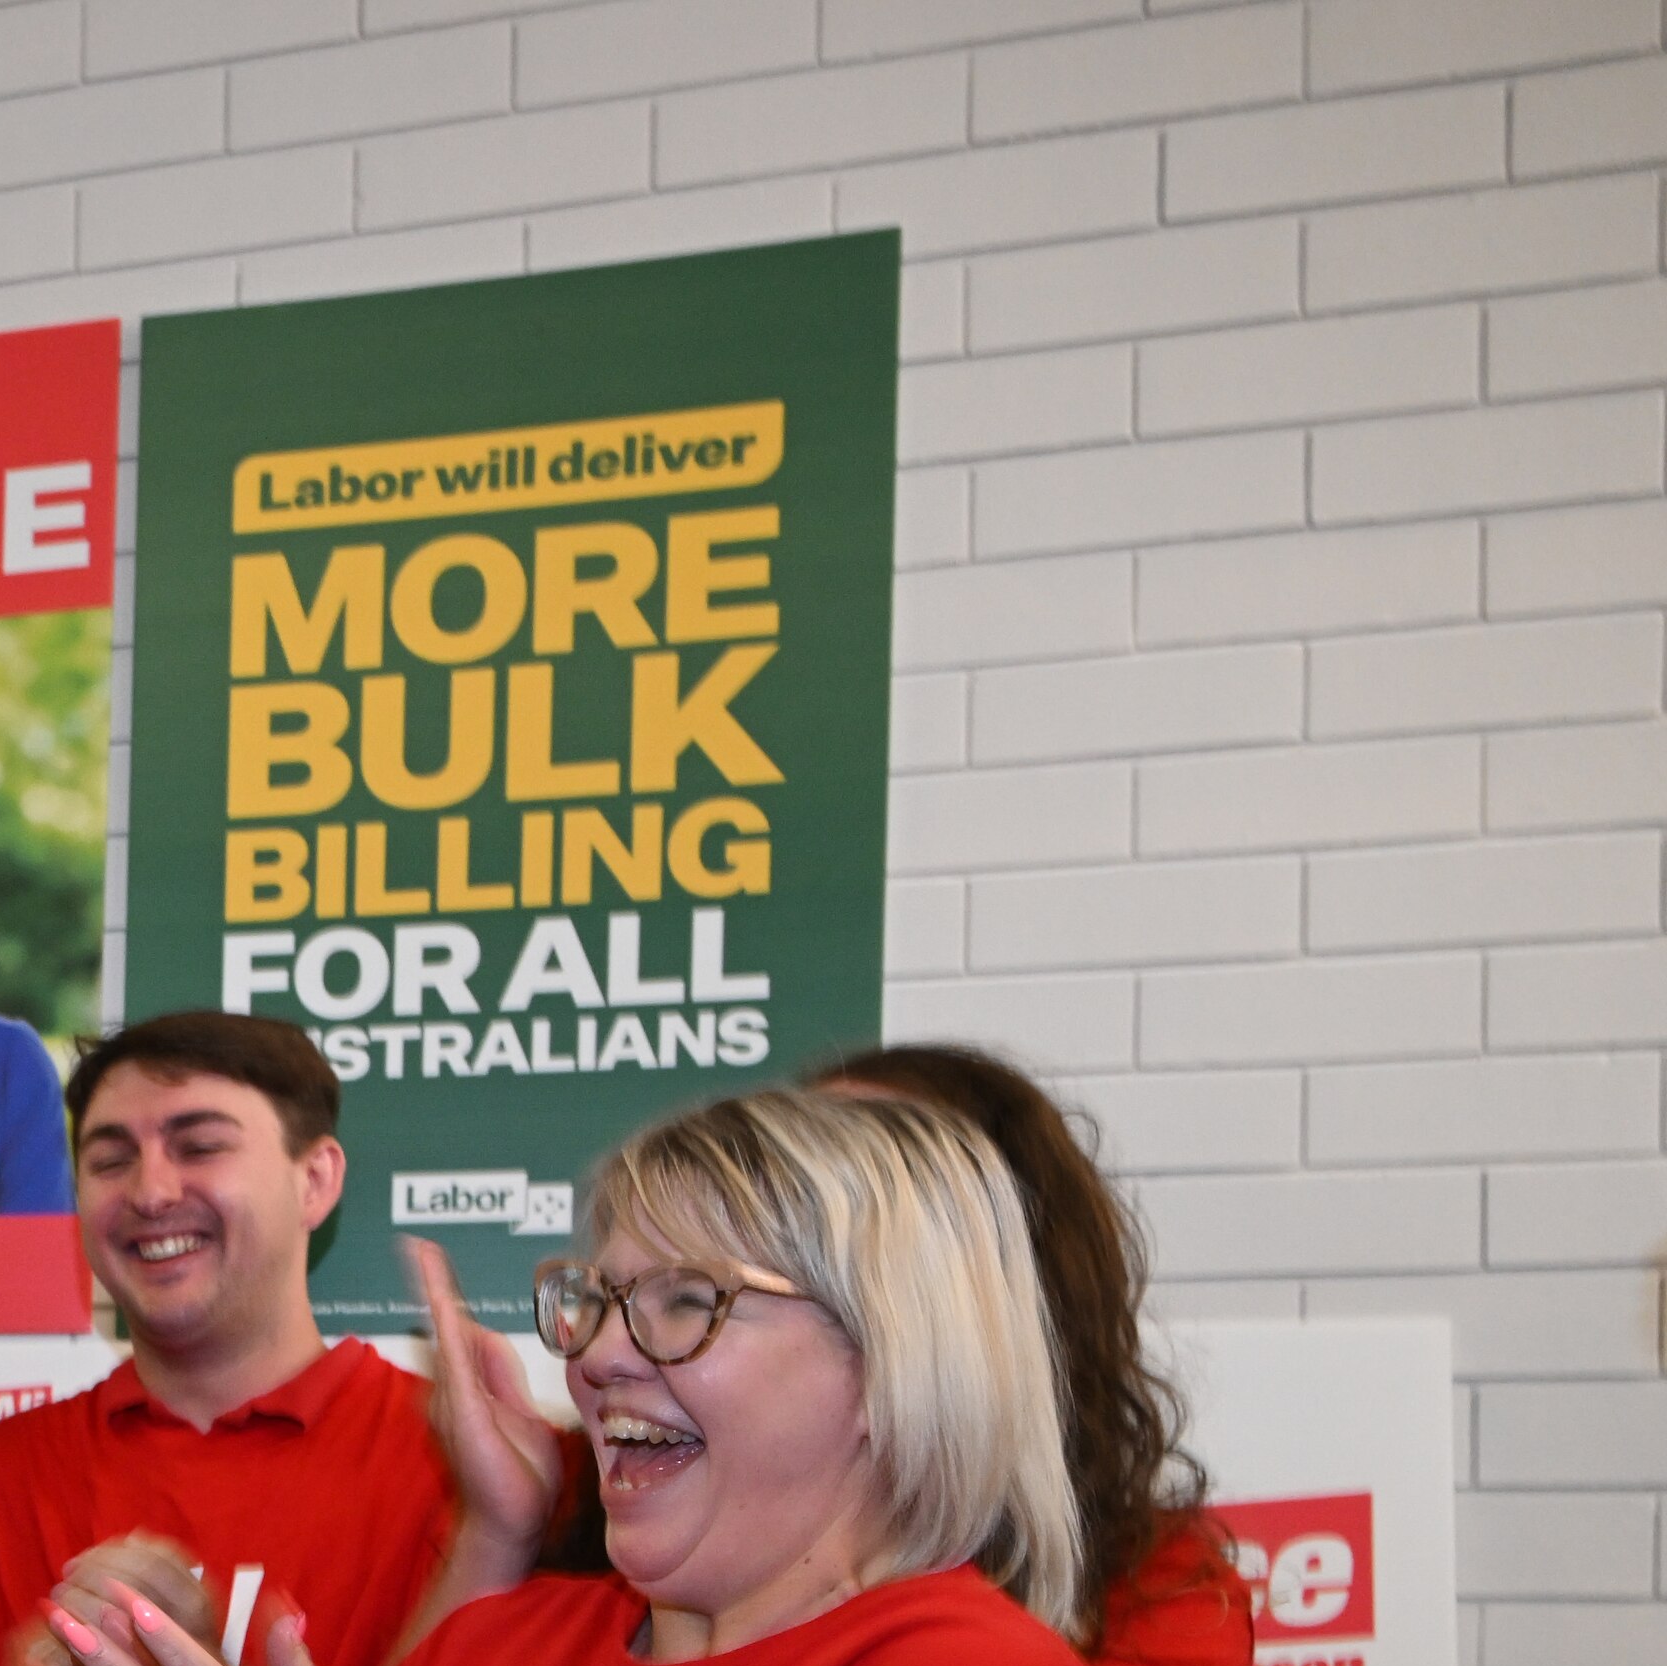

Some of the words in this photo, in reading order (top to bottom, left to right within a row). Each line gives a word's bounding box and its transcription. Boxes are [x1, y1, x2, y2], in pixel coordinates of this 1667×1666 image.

[259, 463, 424, 511] Labor
[435, 444, 535, 495] will
[549, 432, 756, 482] deliver
[230, 505, 780, 678] MORE
[227, 643, 786, 820] BULK
[223, 797, 771, 923] BILLING
[221, 922, 481, 1021] FOR
[499, 907, 770, 1012] ALL
[305, 1008, 770, 1081] STRALIANS
[406, 1180, 514, 1213] Labor
